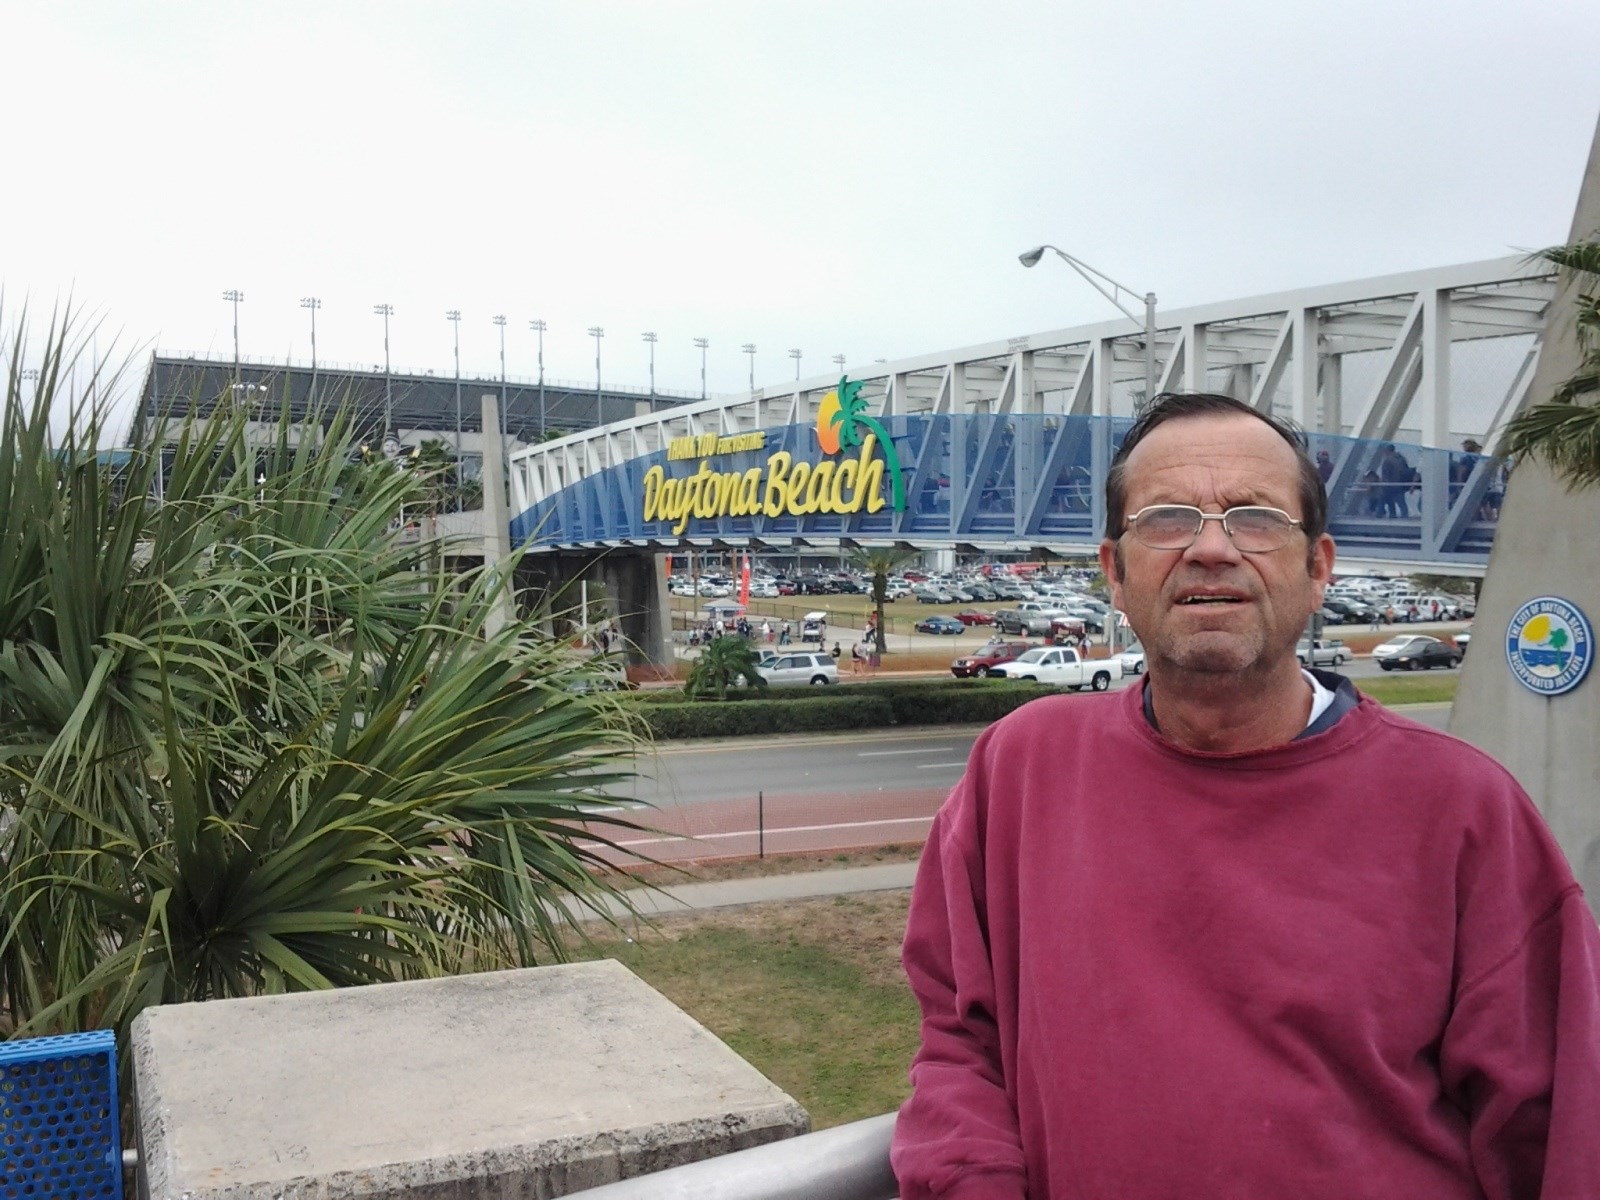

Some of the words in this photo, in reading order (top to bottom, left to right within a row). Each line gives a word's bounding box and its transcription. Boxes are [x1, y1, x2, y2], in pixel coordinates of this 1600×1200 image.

[668, 437, 696, 461] THANK
[696, 432, 717, 458] YOU
[717, 438, 733, 455] FOR
[732, 431, 766, 453] VISITING
[643, 460, 763, 536] Daytona
[762, 433, 887, 518] Beach
[1516, 609, 1530, 624] CITY
[1529, 603, 1539, 614] OF
[1540, 602, 1571, 619] DAYTONA
[1568, 616, 1584, 643] BEACH
[1510, 651, 1554, 689] INCORPORATED
